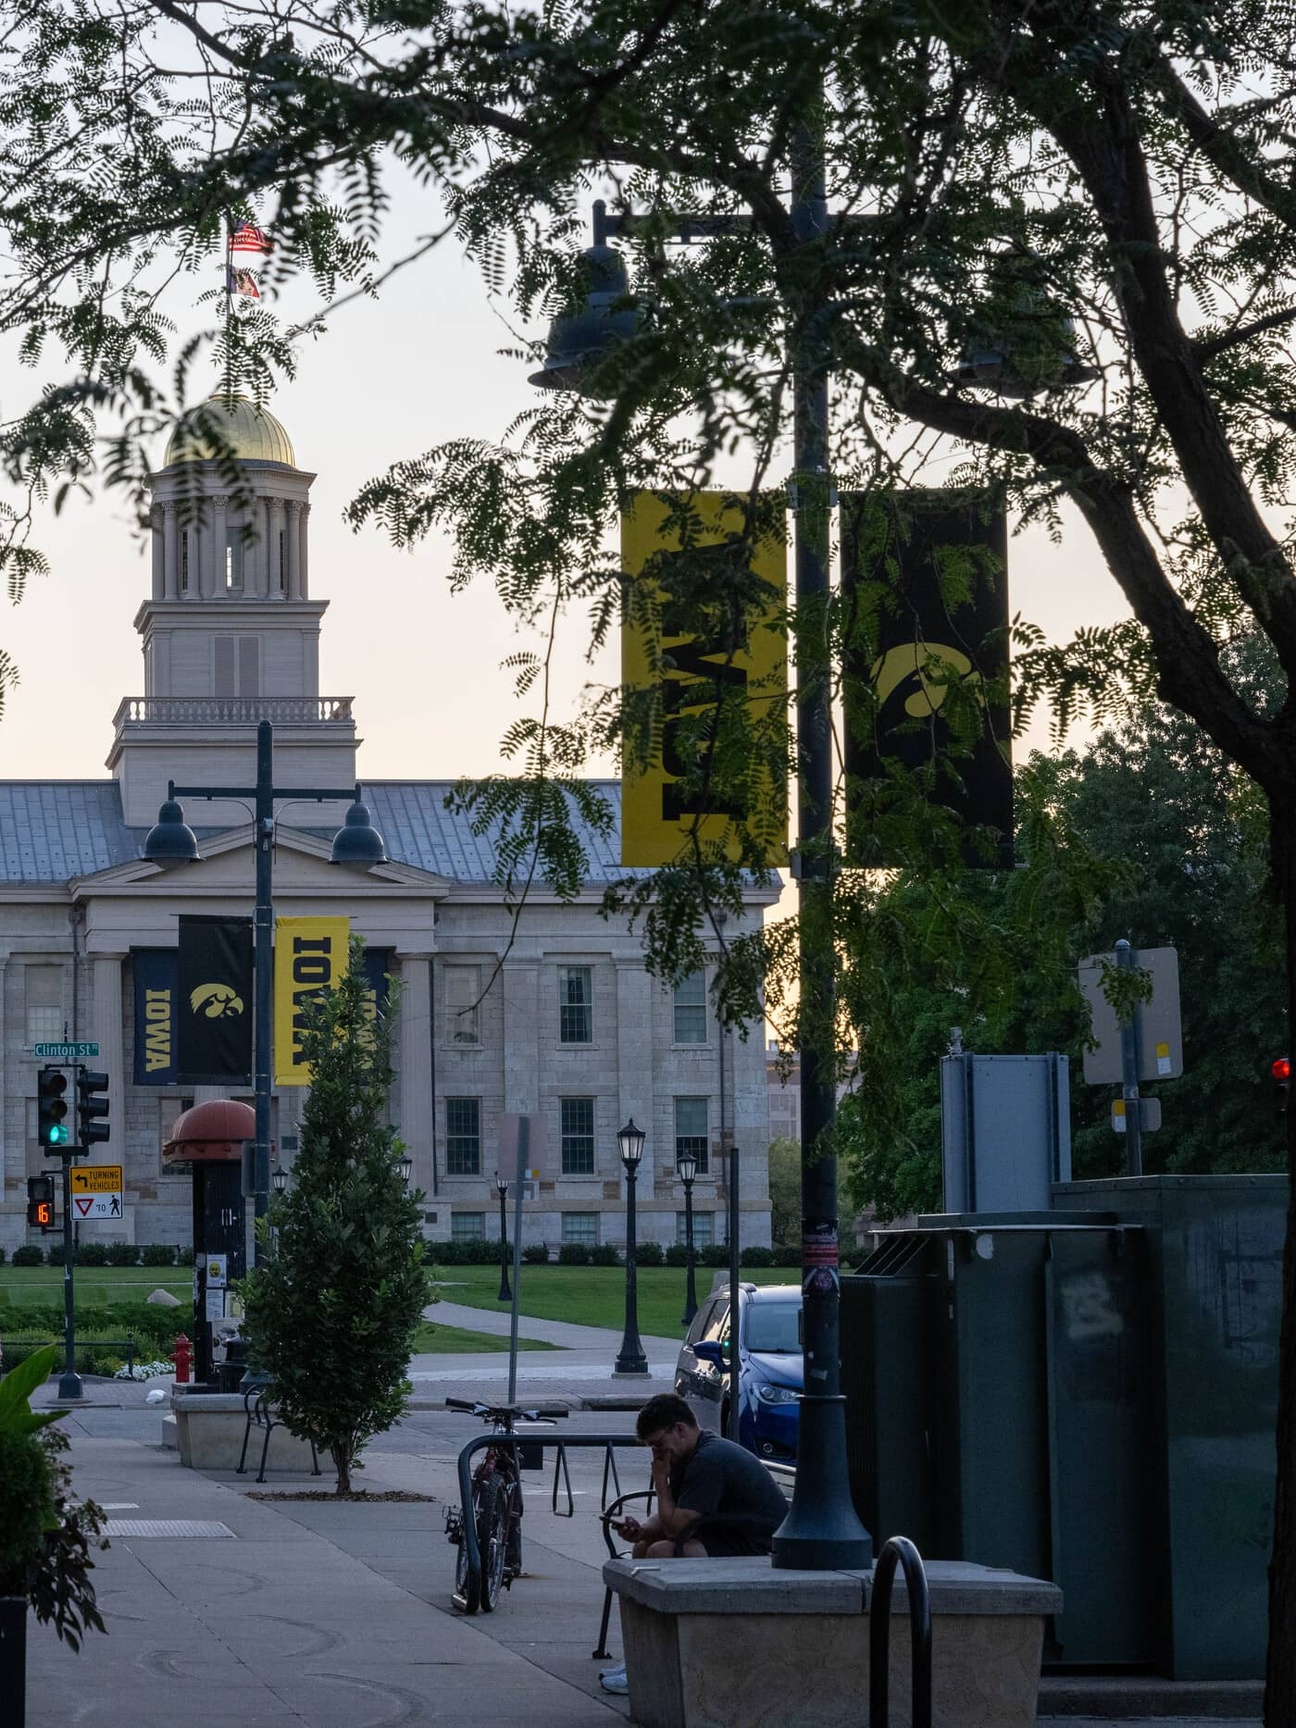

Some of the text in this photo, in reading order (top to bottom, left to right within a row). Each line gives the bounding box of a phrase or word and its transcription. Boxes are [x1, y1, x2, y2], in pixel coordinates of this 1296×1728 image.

[145, 989, 171, 1073] IOWA
[35, 1044, 76, 1056] Clinton
[79, 1044, 91, 1056] St
[89, 1170, 119, 1180] TURNING
[89, 1180, 120, 1190] VEHICLES
[95, 1203, 106, 1212] TO
[38, 1204, 49, 1223] 16
